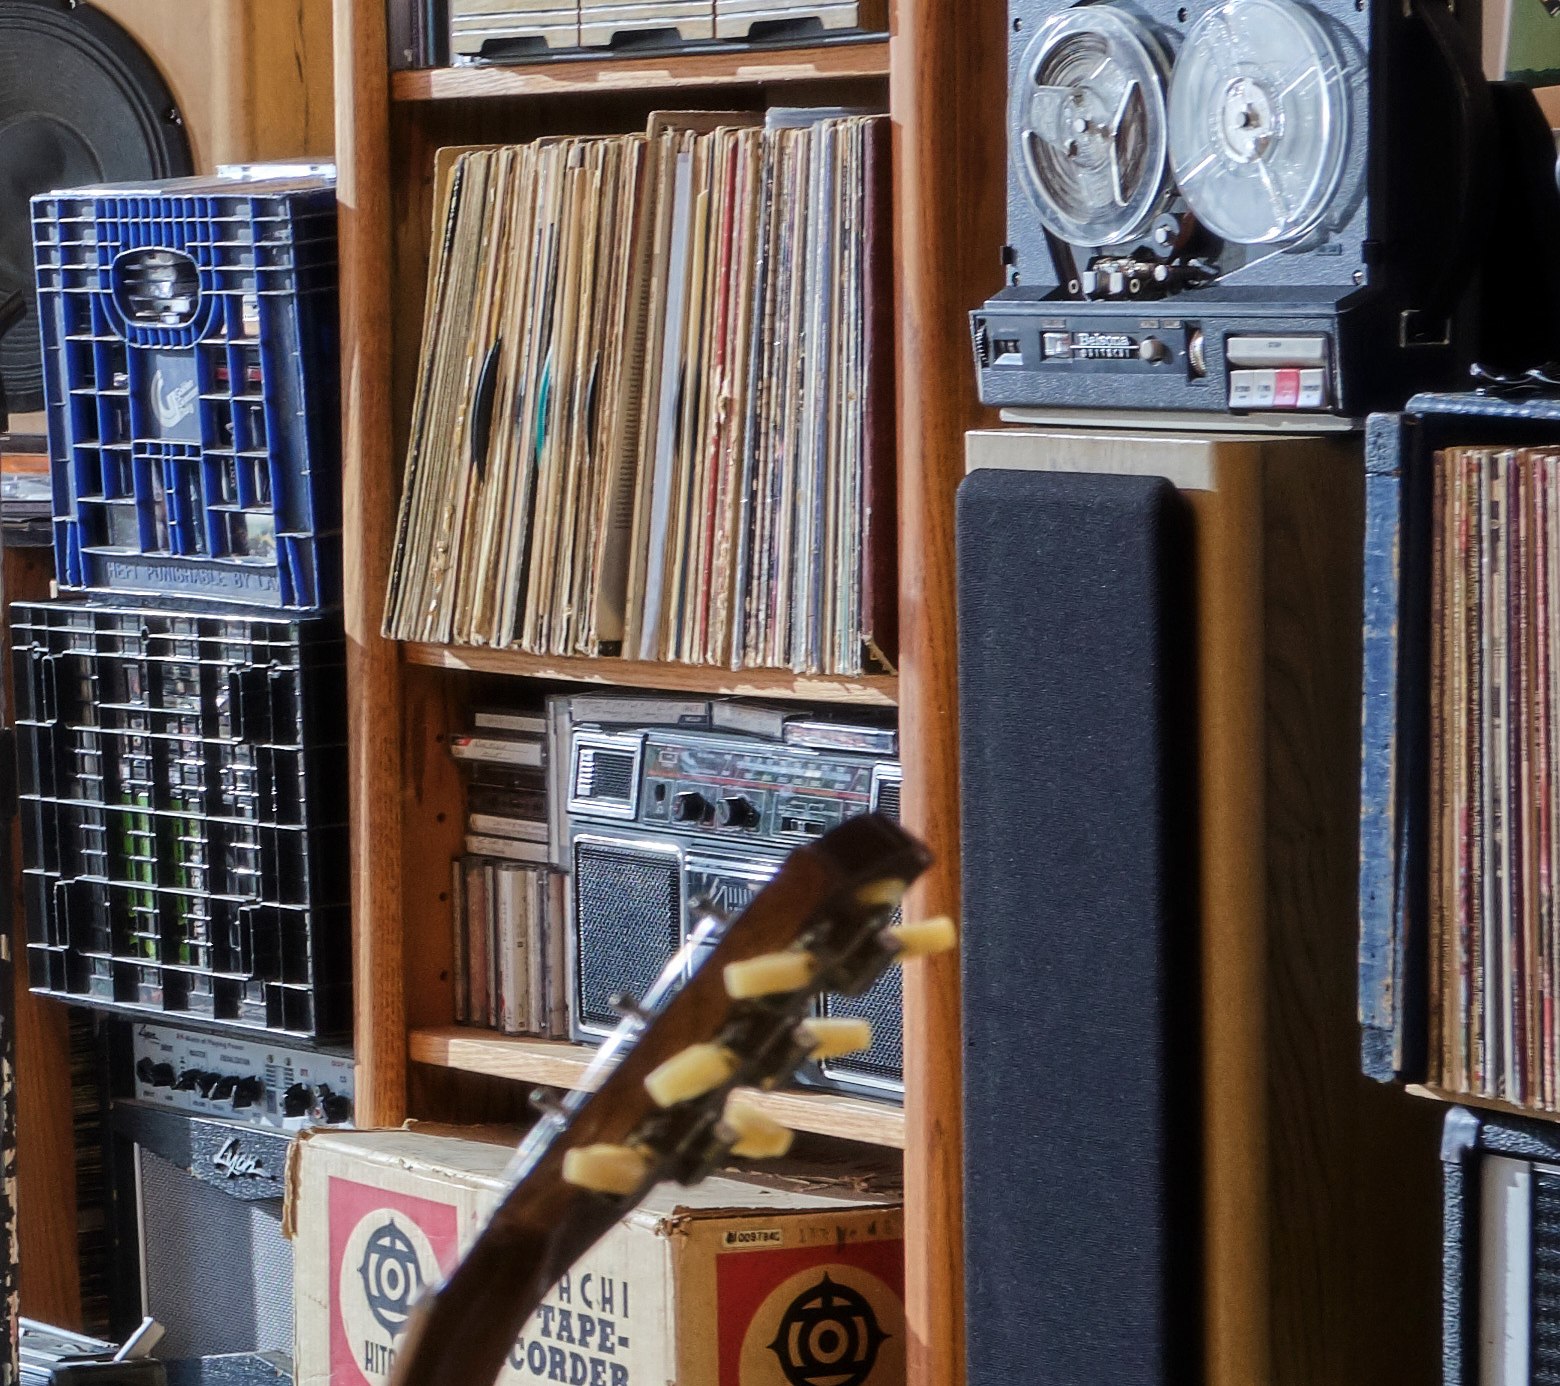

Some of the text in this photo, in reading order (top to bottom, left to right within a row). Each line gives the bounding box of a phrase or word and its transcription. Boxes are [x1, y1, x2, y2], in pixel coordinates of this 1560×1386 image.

[106, 561, 138, 581] HEFT
[146, 565, 228, 588] PUNISHABLE
[558, 1270, 630, 1320] ACHI
